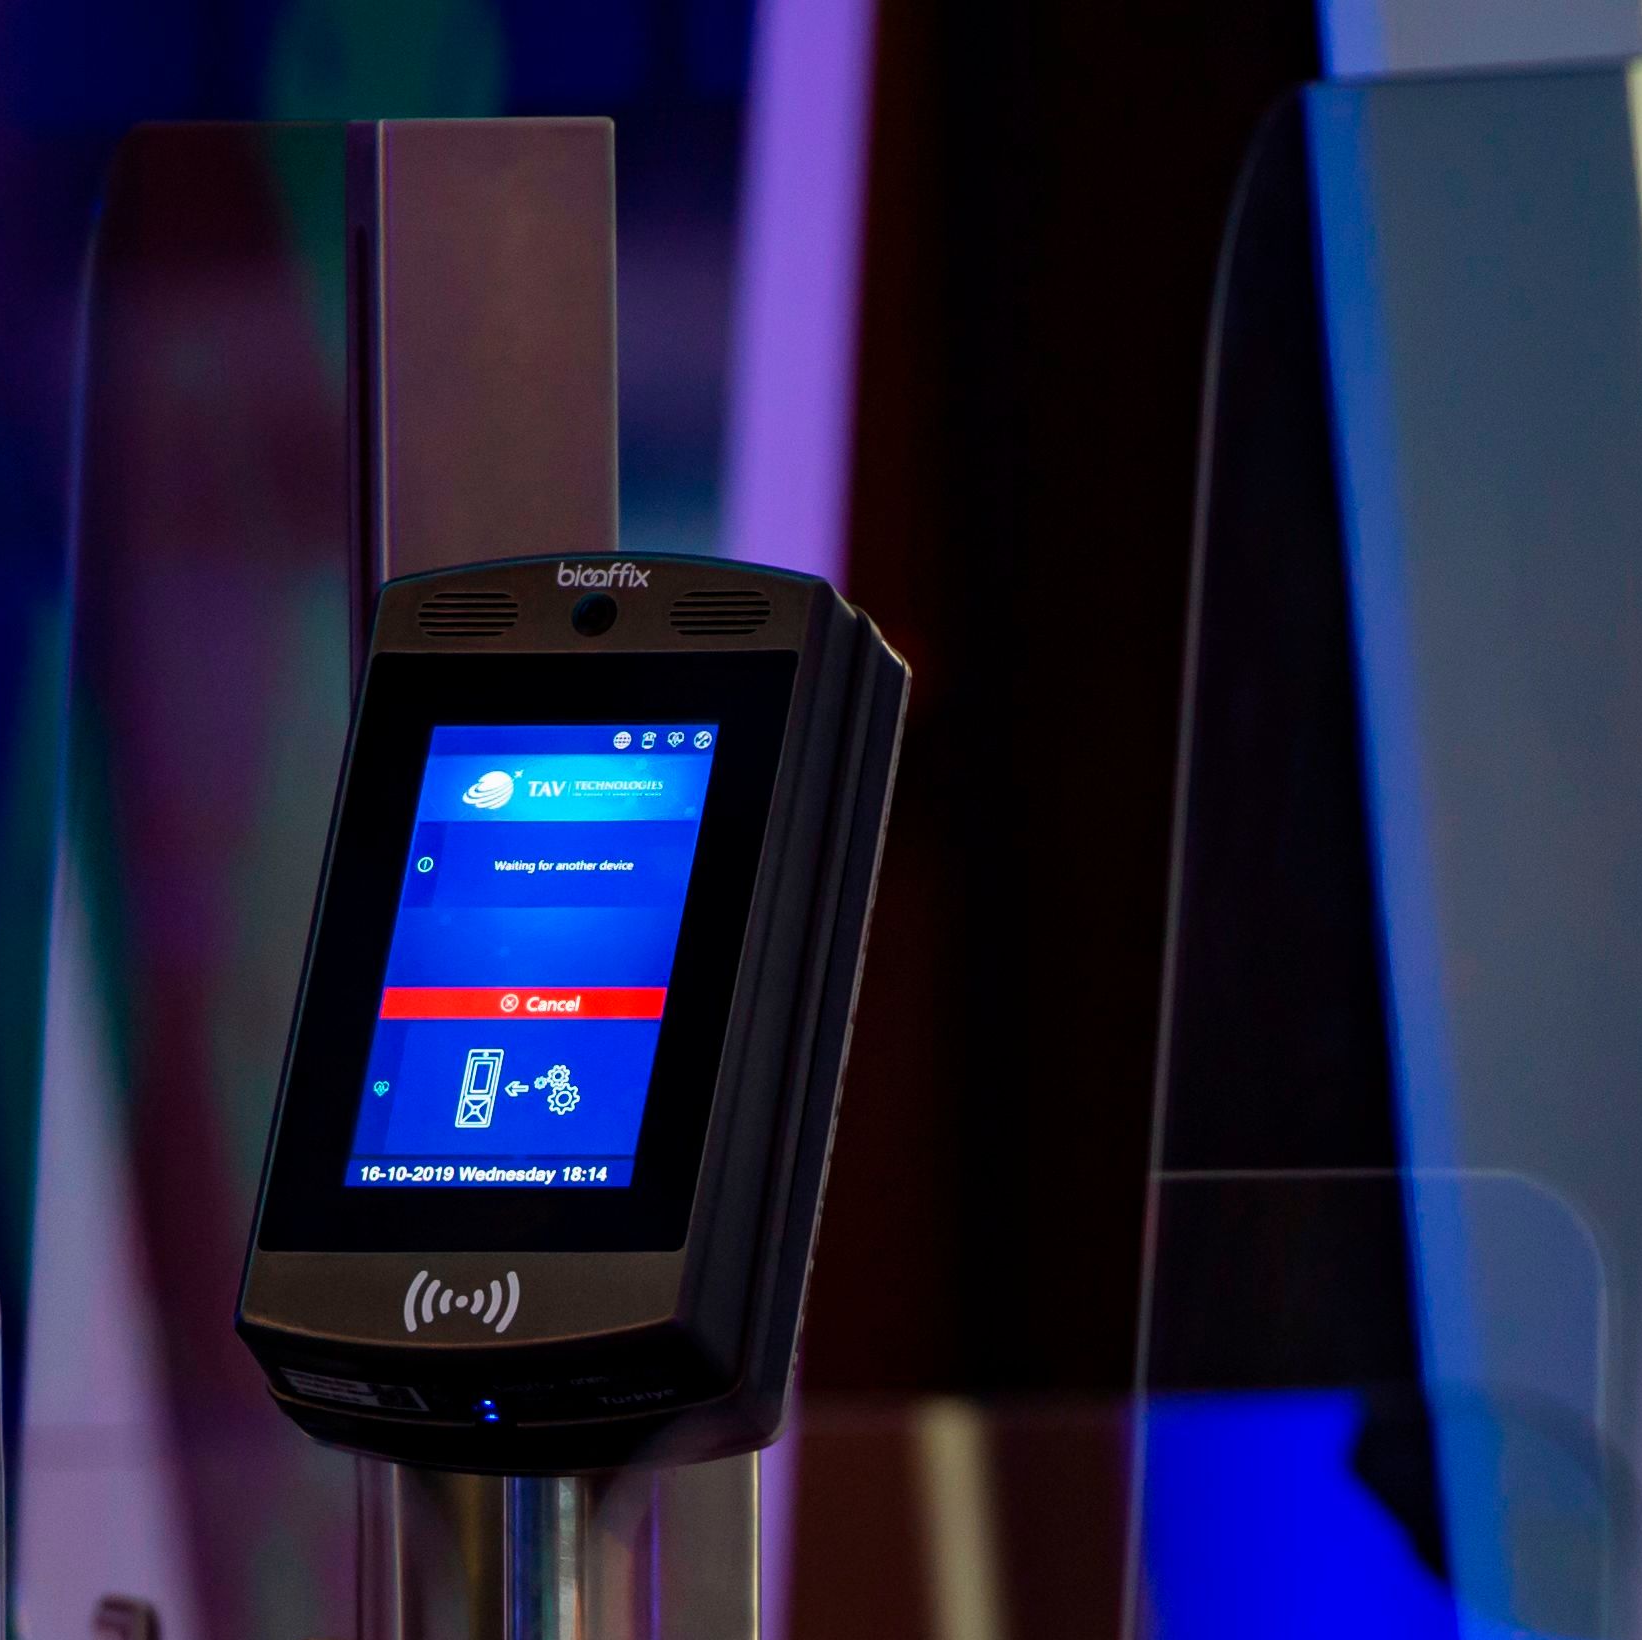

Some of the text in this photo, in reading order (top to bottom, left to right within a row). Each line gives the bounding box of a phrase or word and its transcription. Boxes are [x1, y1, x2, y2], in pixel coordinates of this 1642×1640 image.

[557, 561, 651, 588] bioaffix
[528, 780, 566, 797] TAV
[574, 780, 664, 791] TECHNOLOGIES
[494, 860, 635, 874] Waiting for another device
[526, 995, 581, 1012] Cancel
[360, 1165, 607, 1185] 16-10-2019 Wednesday 18:14
